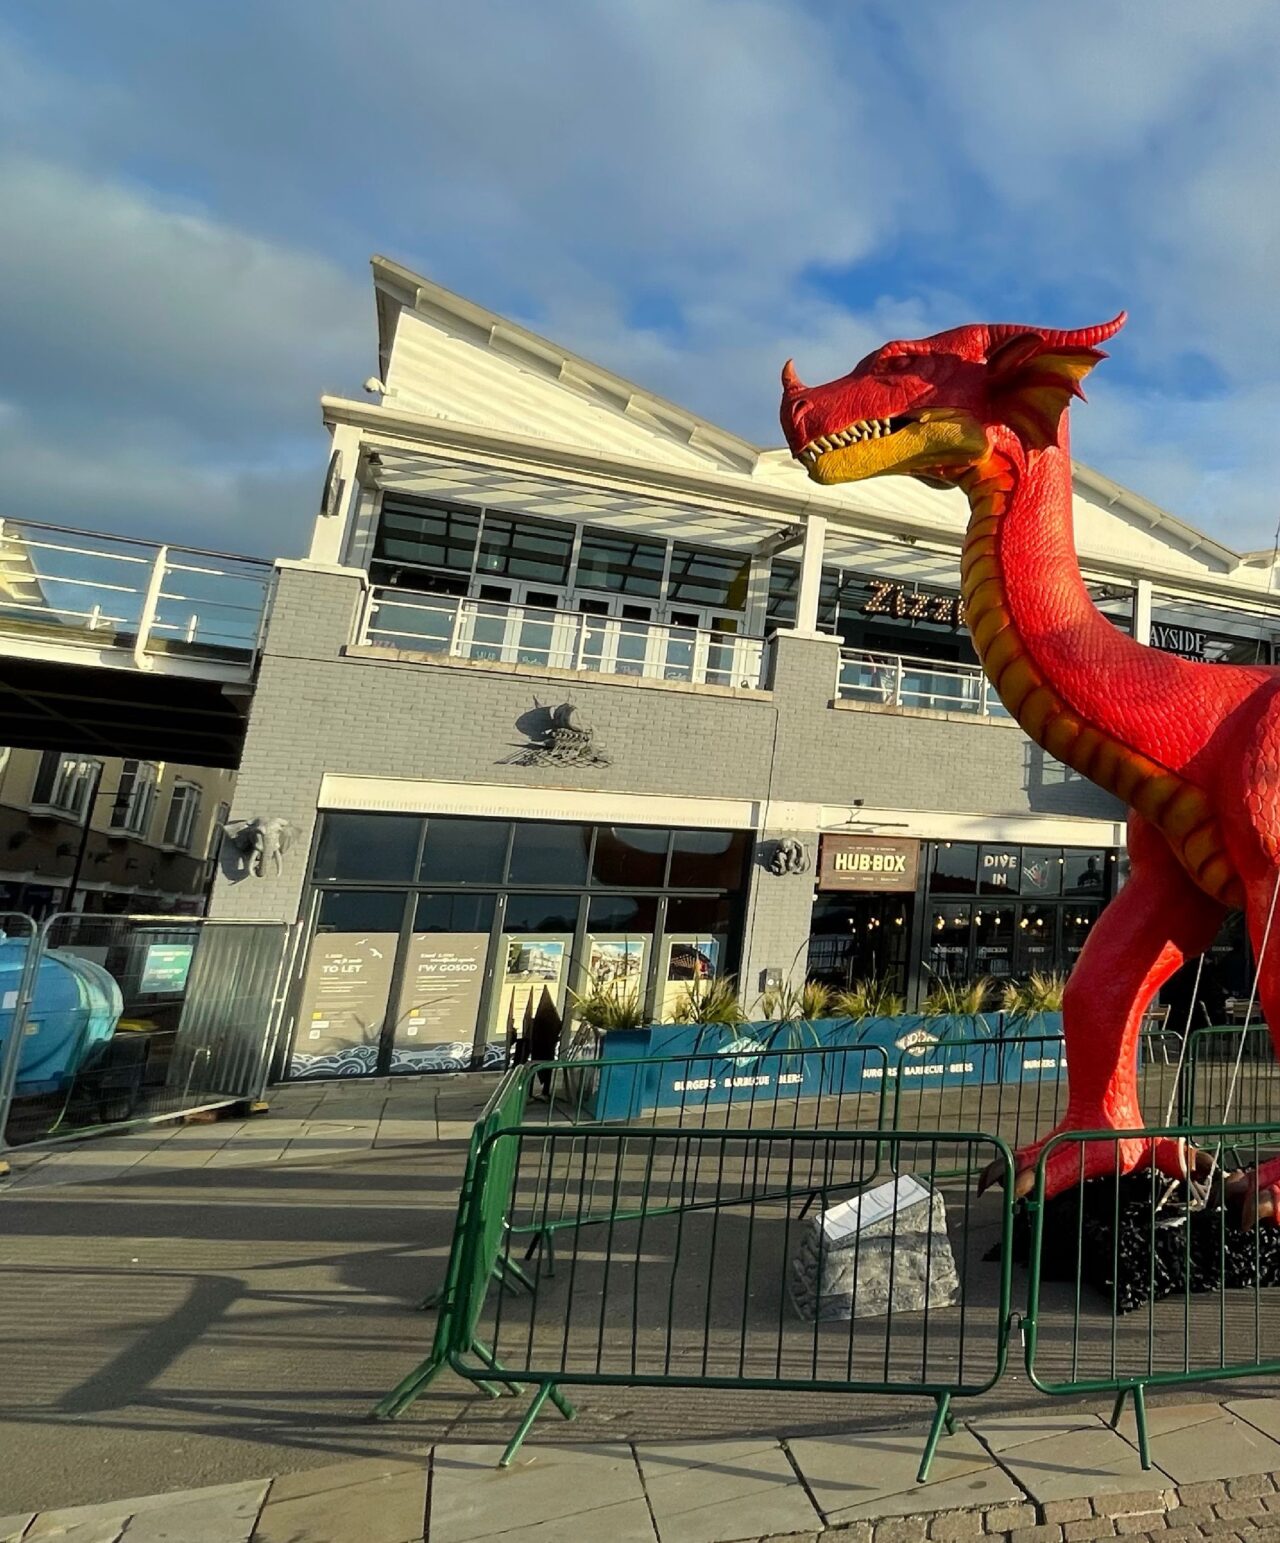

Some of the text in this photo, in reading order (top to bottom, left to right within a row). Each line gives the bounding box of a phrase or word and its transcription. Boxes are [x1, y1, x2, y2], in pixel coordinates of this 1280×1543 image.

[1150, 625, 1207, 653] AYSIDE
[984, 854, 1017, 868] DIVE
[992, 873, 1007, 886] IN
[323, 964, 363, 973] TO LET
[440, 964, 478, 972] GOSOD
